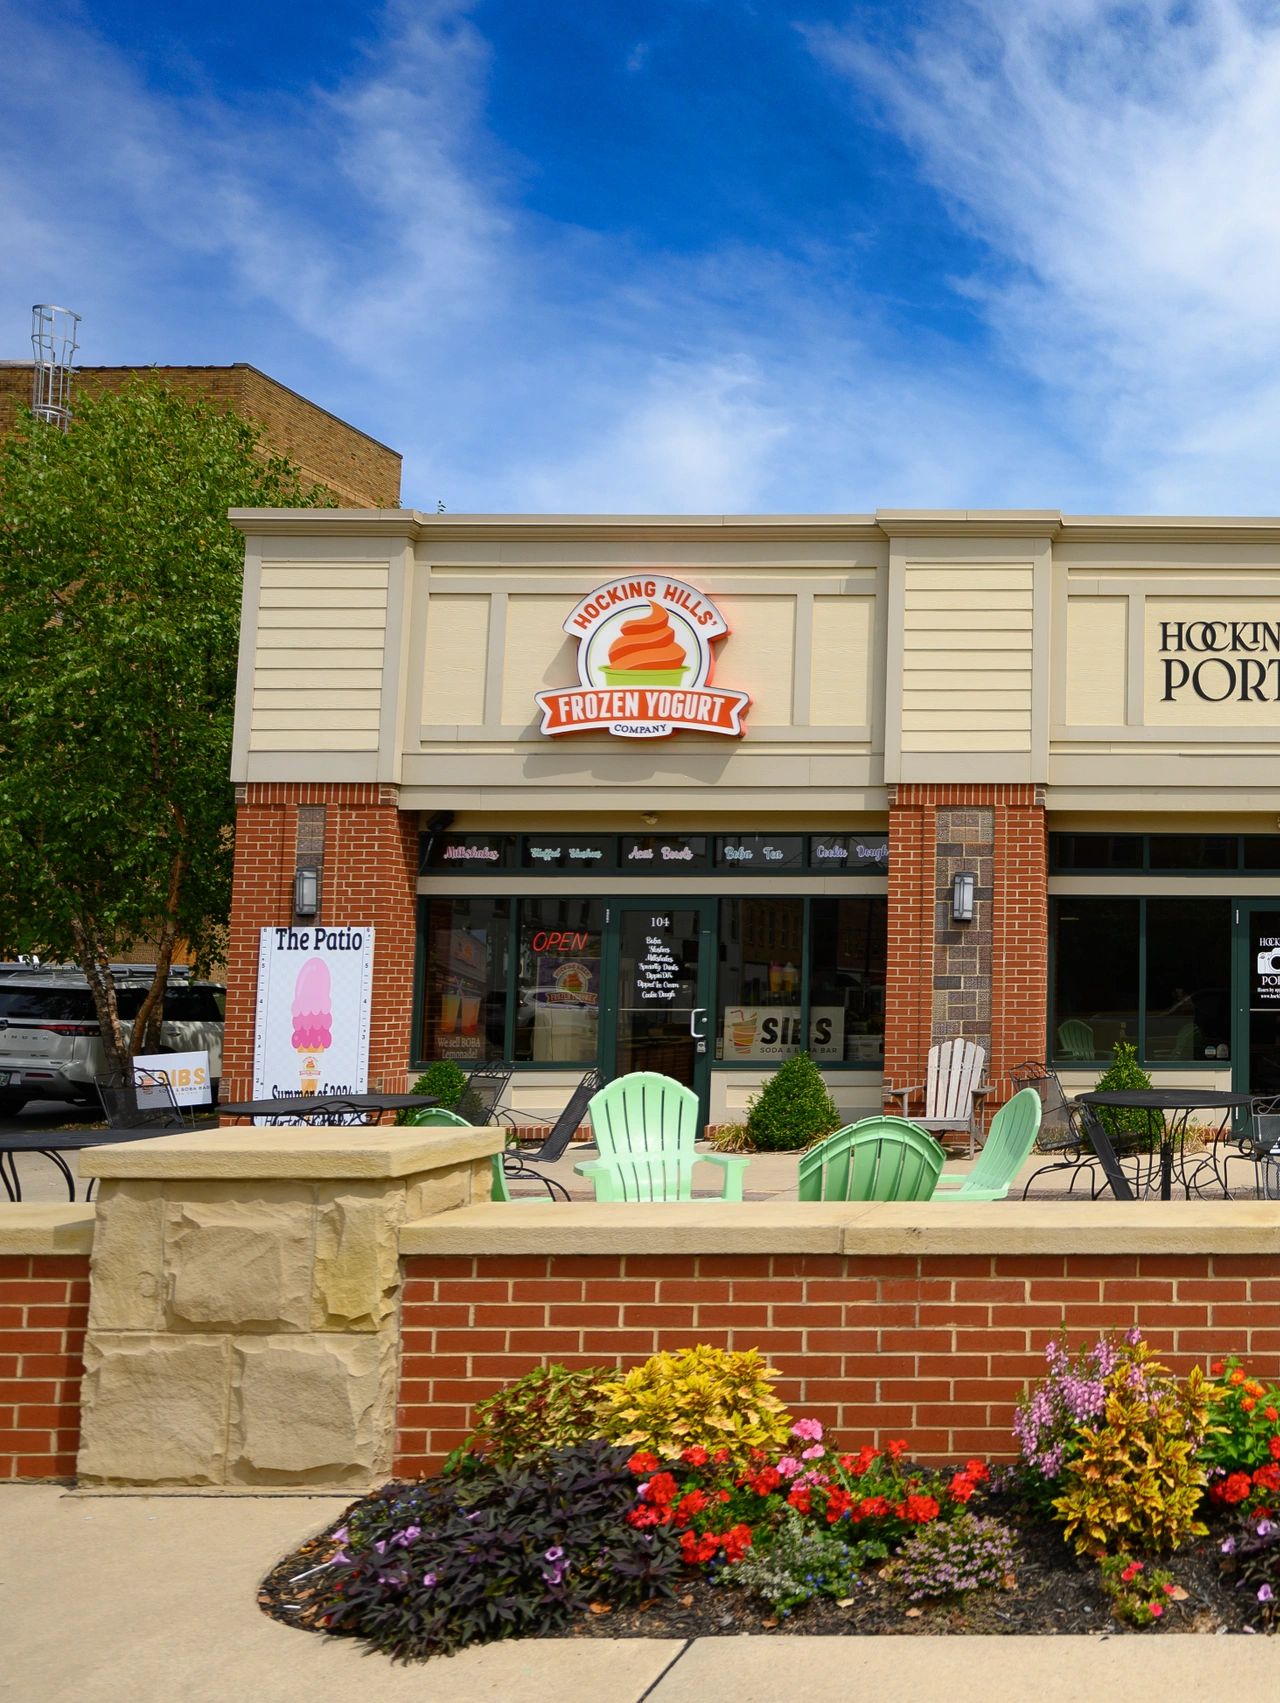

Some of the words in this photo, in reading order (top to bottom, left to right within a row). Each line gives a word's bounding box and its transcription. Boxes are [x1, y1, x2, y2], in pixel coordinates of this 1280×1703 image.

[573, 581, 656, 630] HOCKING
[663, 584, 718, 627] HILLS'
[558, 692, 639, 723] FROZEN
[645, 692, 725, 723] YOGURT
[614, 724, 667, 734] COMPANY
[444, 846, 499, 860] Milkshakes
[724, 846, 753, 860] Boba
[762, 846, 784, 860] Tea
[816, 845, 848, 857] Cookie
[856, 844, 888, 861] Dough
[651, 917, 670, 927] 104
[275, 927, 309, 950] The
[313, 927, 362, 951] Patio
[532, 931, 588, 951] OPEN
[461, 1037, 480, 1047] BOBA
